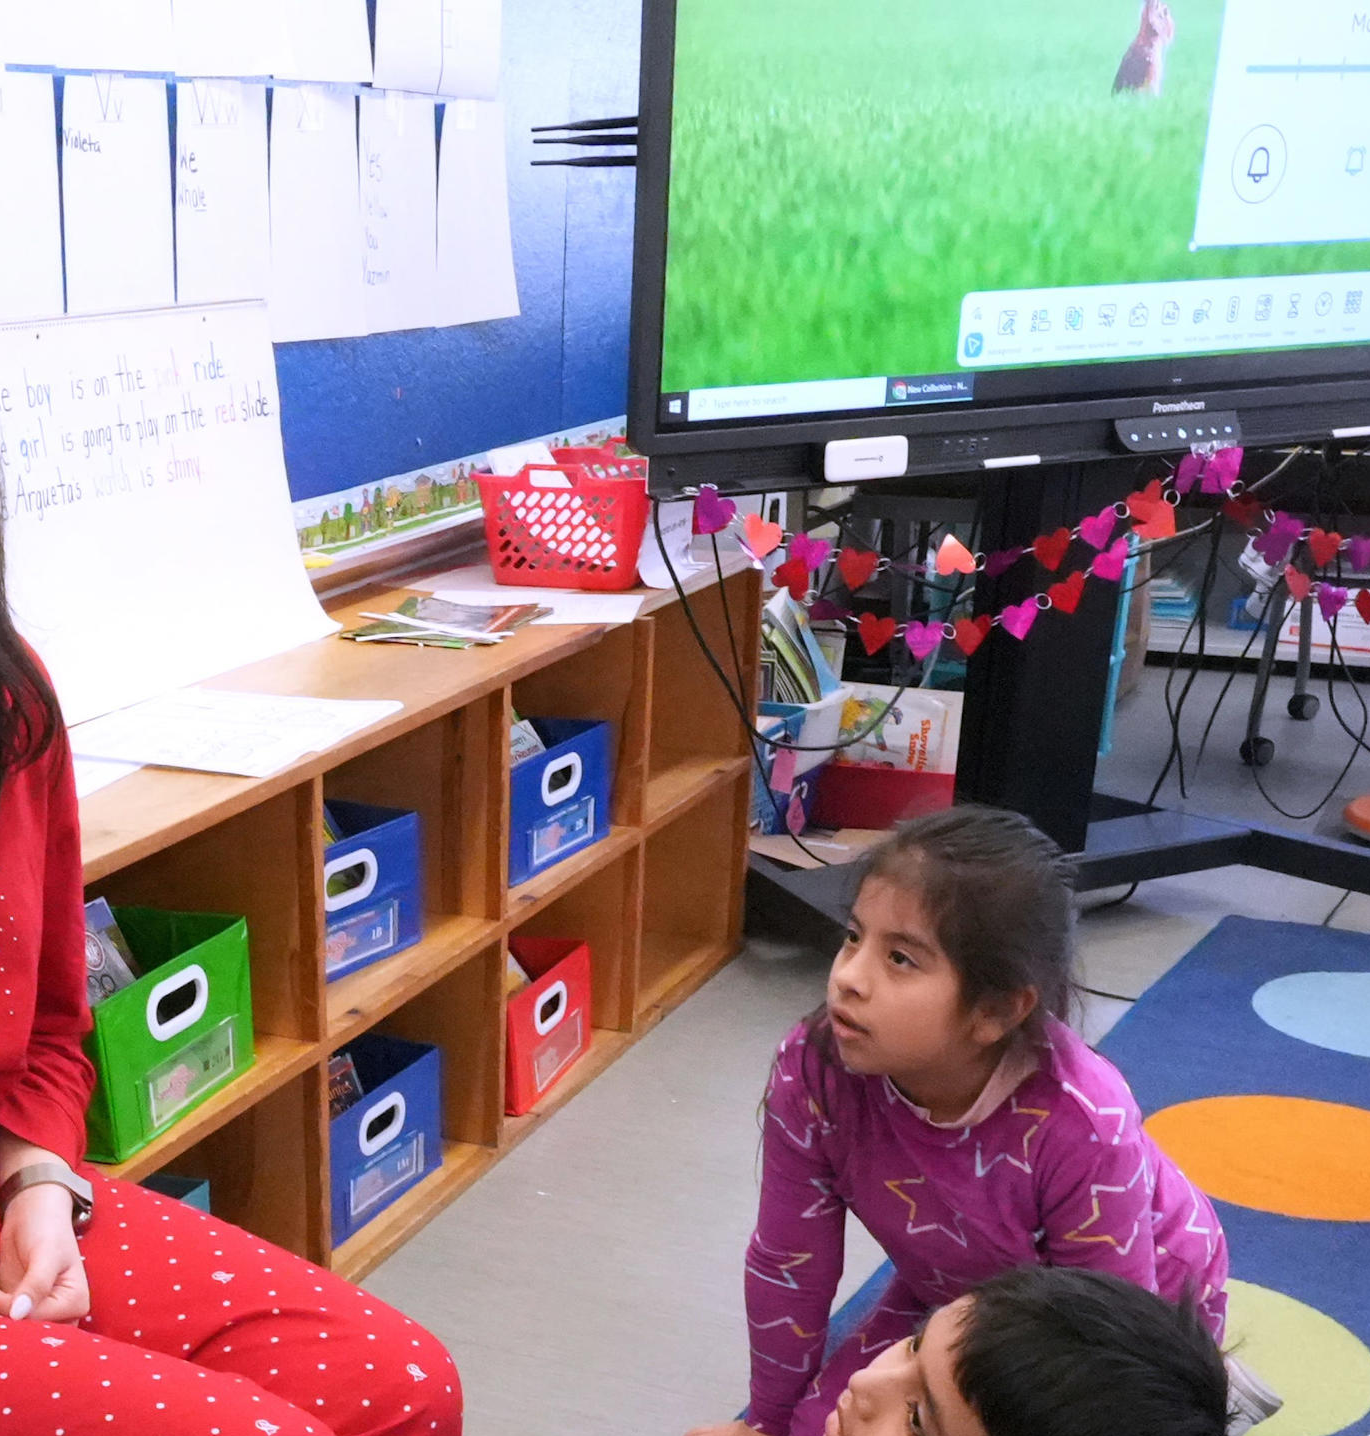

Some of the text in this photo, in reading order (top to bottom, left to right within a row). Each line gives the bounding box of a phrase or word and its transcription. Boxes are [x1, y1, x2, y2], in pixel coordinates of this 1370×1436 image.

[93, 74, 123, 121] Vv
[63, 127, 102, 154] Violeta
[180, 144, 198, 173] We
[23, 367, 52, 417] boy
[69, 368, 84, 400] is
[93, 373, 110, 397] on
[114, 353, 146, 393] the
[1153, 400, 1205, 414] Promethean
[19, 416, 47, 474] girl
[60, 426, 74, 452] is
[82, 423, 113, 459] going
[115, 403, 132, 442] to
[135, 400, 160, 449] play
[164, 411, 179, 435] on
[181, 390, 207, 430] the
[215, 381, 237, 425] red
[141, 463, 155, 489] is
